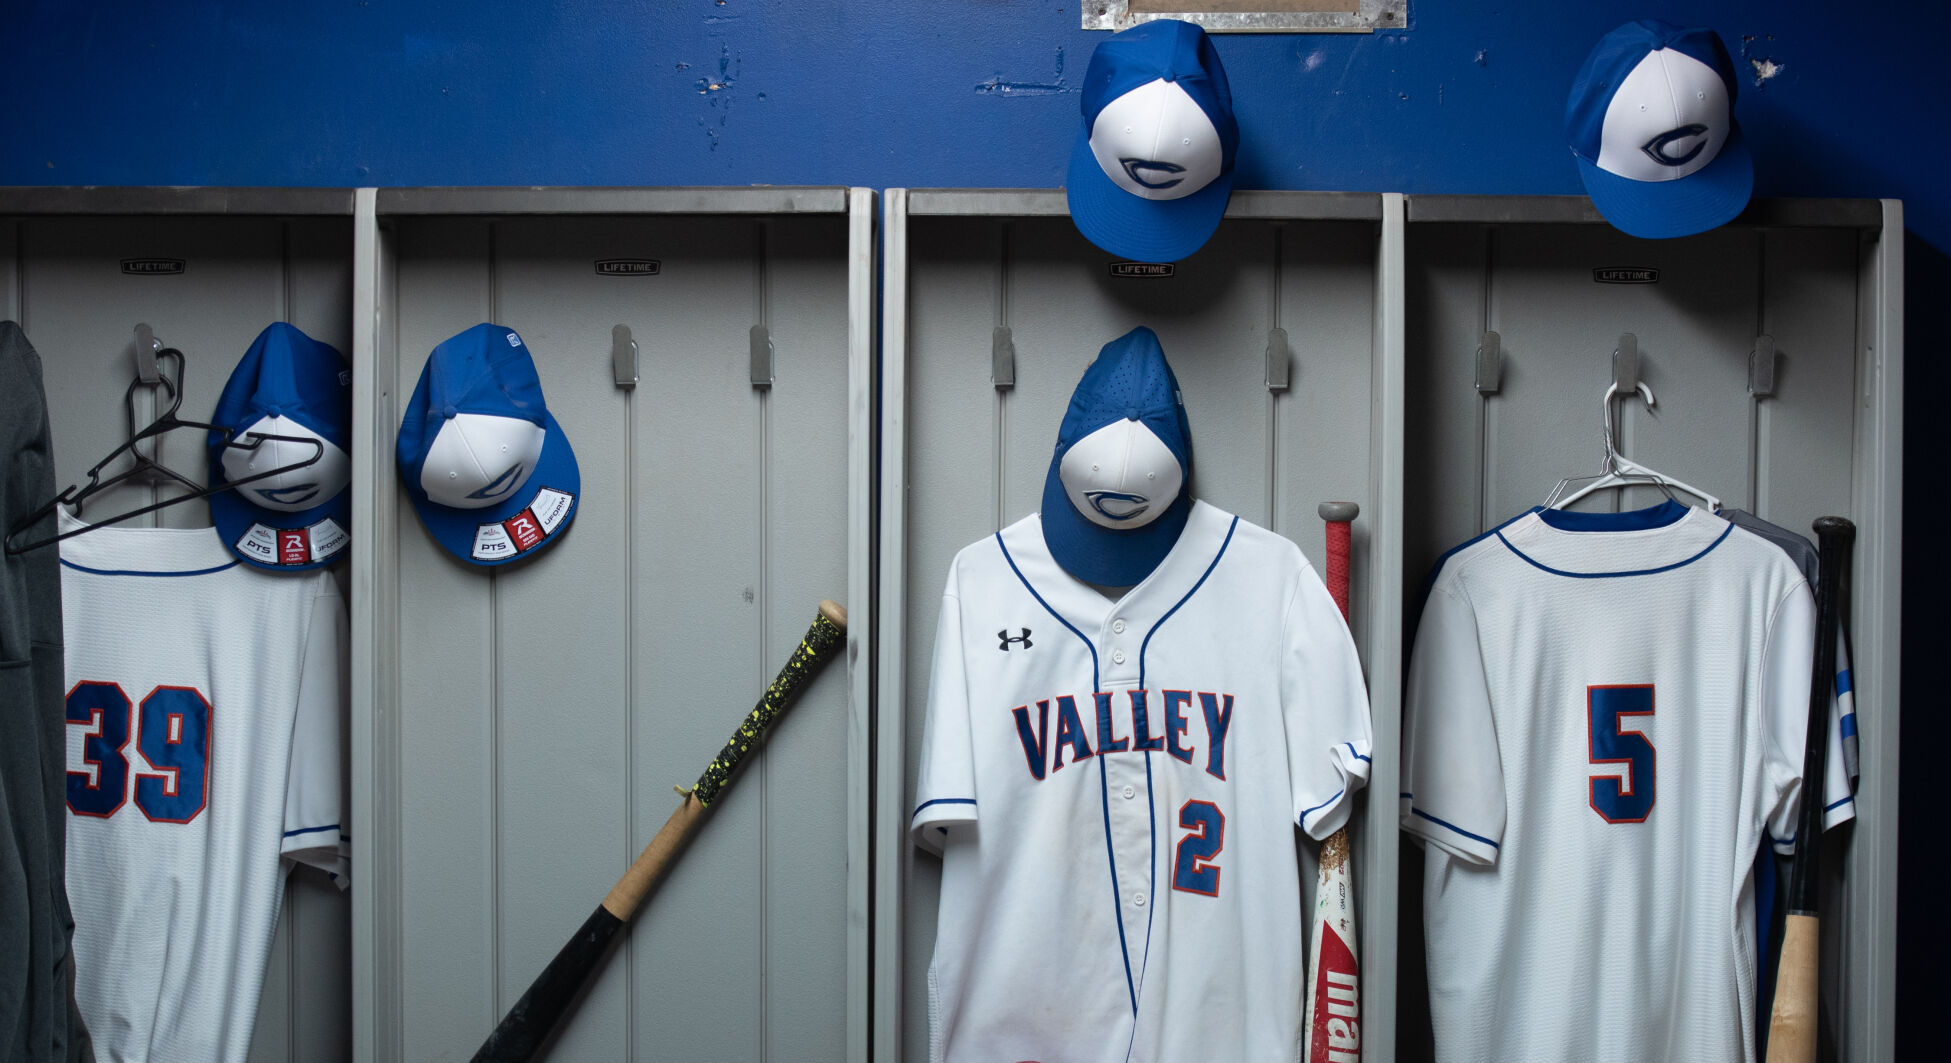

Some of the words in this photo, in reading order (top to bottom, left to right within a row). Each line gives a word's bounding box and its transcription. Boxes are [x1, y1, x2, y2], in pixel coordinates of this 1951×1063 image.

[129, 263, 177, 271] LIFETIME
[603, 263, 652, 272] LIFETIME
[1118, 265, 1167, 274] LIFETIME
[1602, 271, 1651, 280] LIFETIME
[544, 496, 566, 525] UFORM
[246, 540, 271, 555] PTS
[481, 541, 507, 551] PTS
[1012, 689, 1234, 781] VALLEY
[65, 680, 213, 824] 39
[1587, 683, 1656, 824] 5
[1172, 798, 1225, 897] 2
